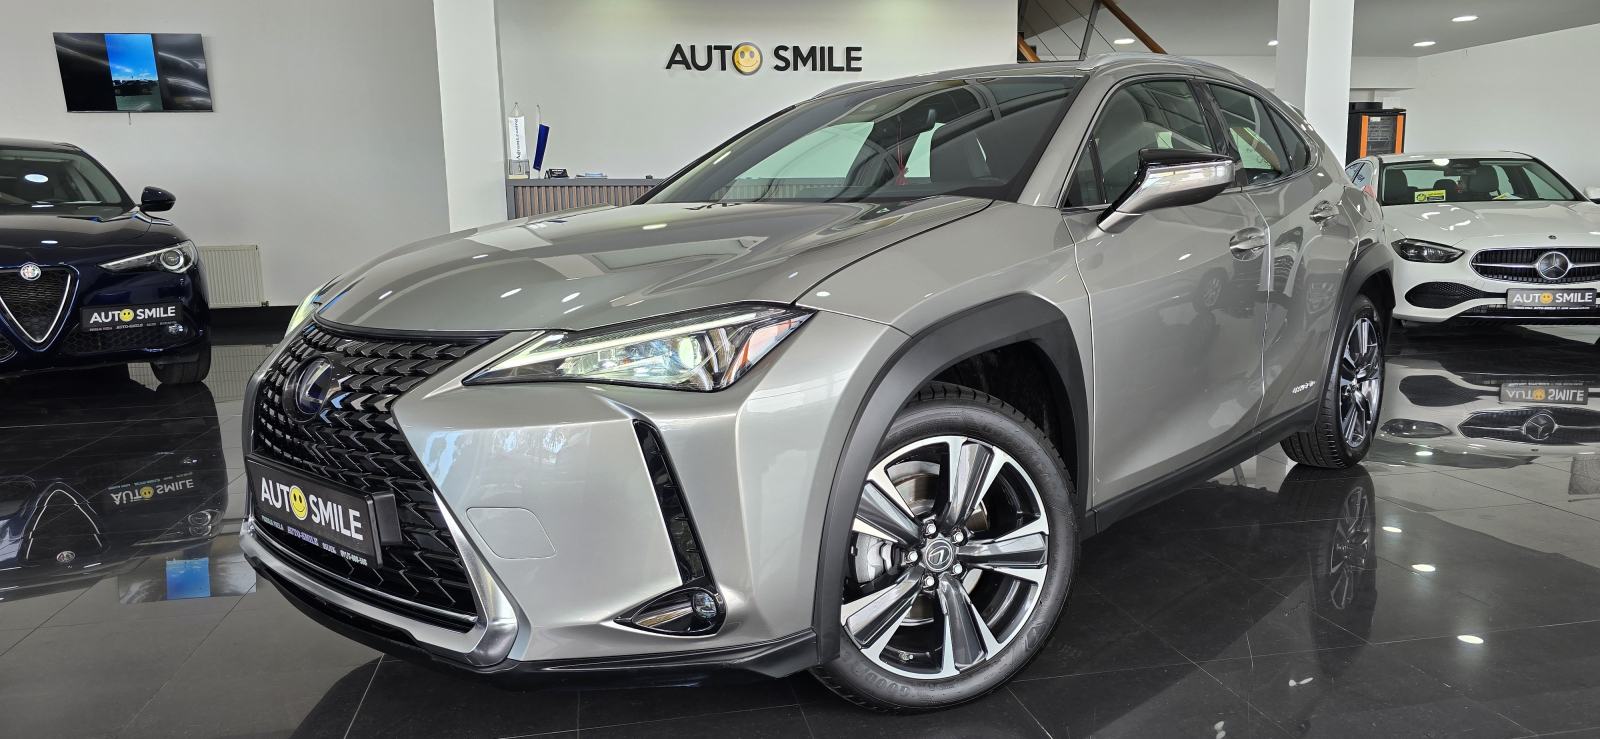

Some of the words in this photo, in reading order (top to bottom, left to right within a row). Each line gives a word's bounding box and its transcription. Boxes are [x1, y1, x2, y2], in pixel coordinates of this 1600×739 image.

[773, 45, 862, 72] SMILE
[1555, 292, 1593, 303] SMILE
[136, 306, 175, 320] SMILE
[309, 495, 364, 541] SMILE
